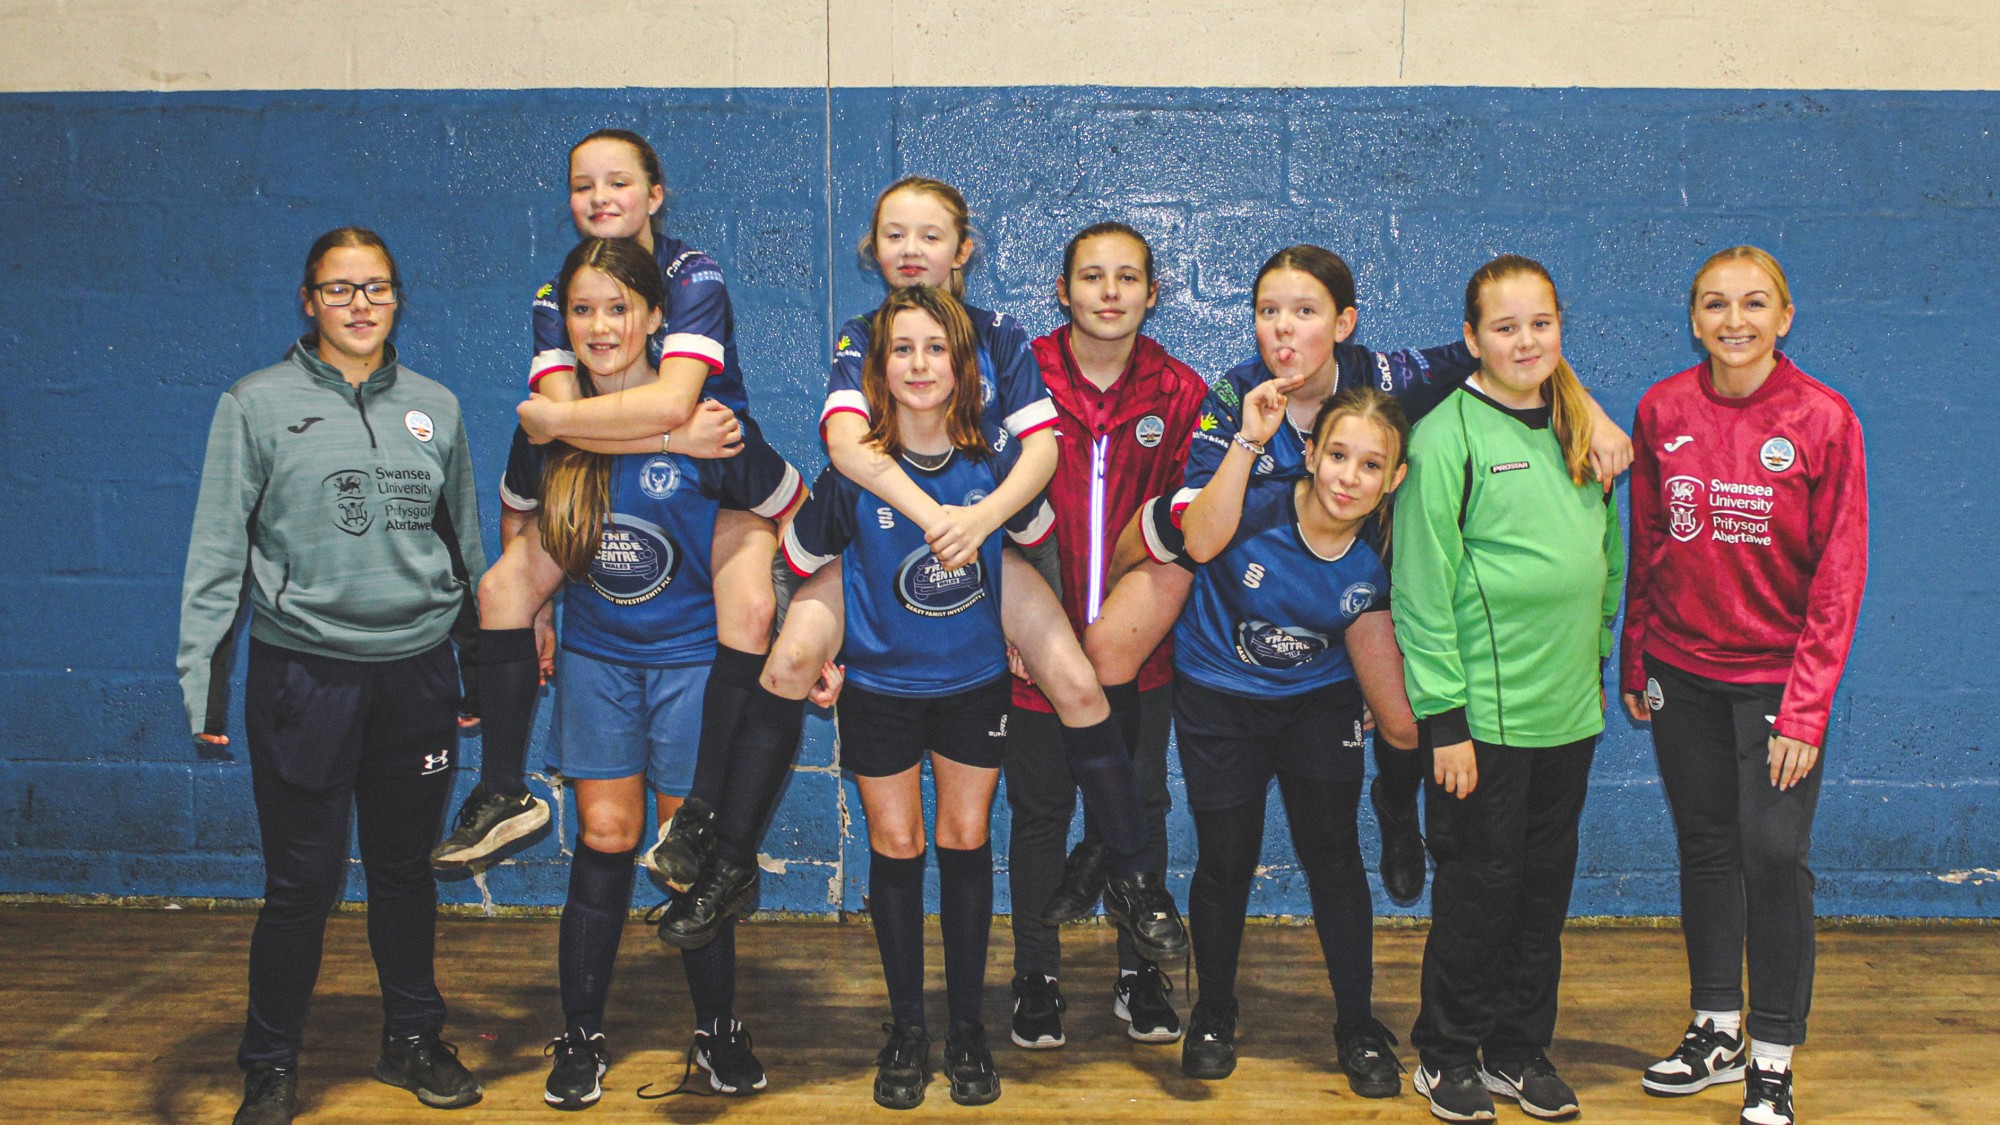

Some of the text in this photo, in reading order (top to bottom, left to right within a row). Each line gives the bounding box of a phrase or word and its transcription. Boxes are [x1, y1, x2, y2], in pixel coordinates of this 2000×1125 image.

[375, 467, 431, 480] Swansea
[378, 482, 432, 495] University
[1710, 479, 1774, 496] Swansea
[1709, 494, 1774, 513] University
[1713, 516, 1768, 534] Prifysgol
[601, 541, 643, 550] RADE
[1712, 530, 1772, 546] Abertawe
[615, 590, 661, 605] INVESTMENTS
[660, 576, 672, 588] PLC
[905, 602, 926, 617] BAILEY
[947, 595, 982, 616] INVESTMENTS
